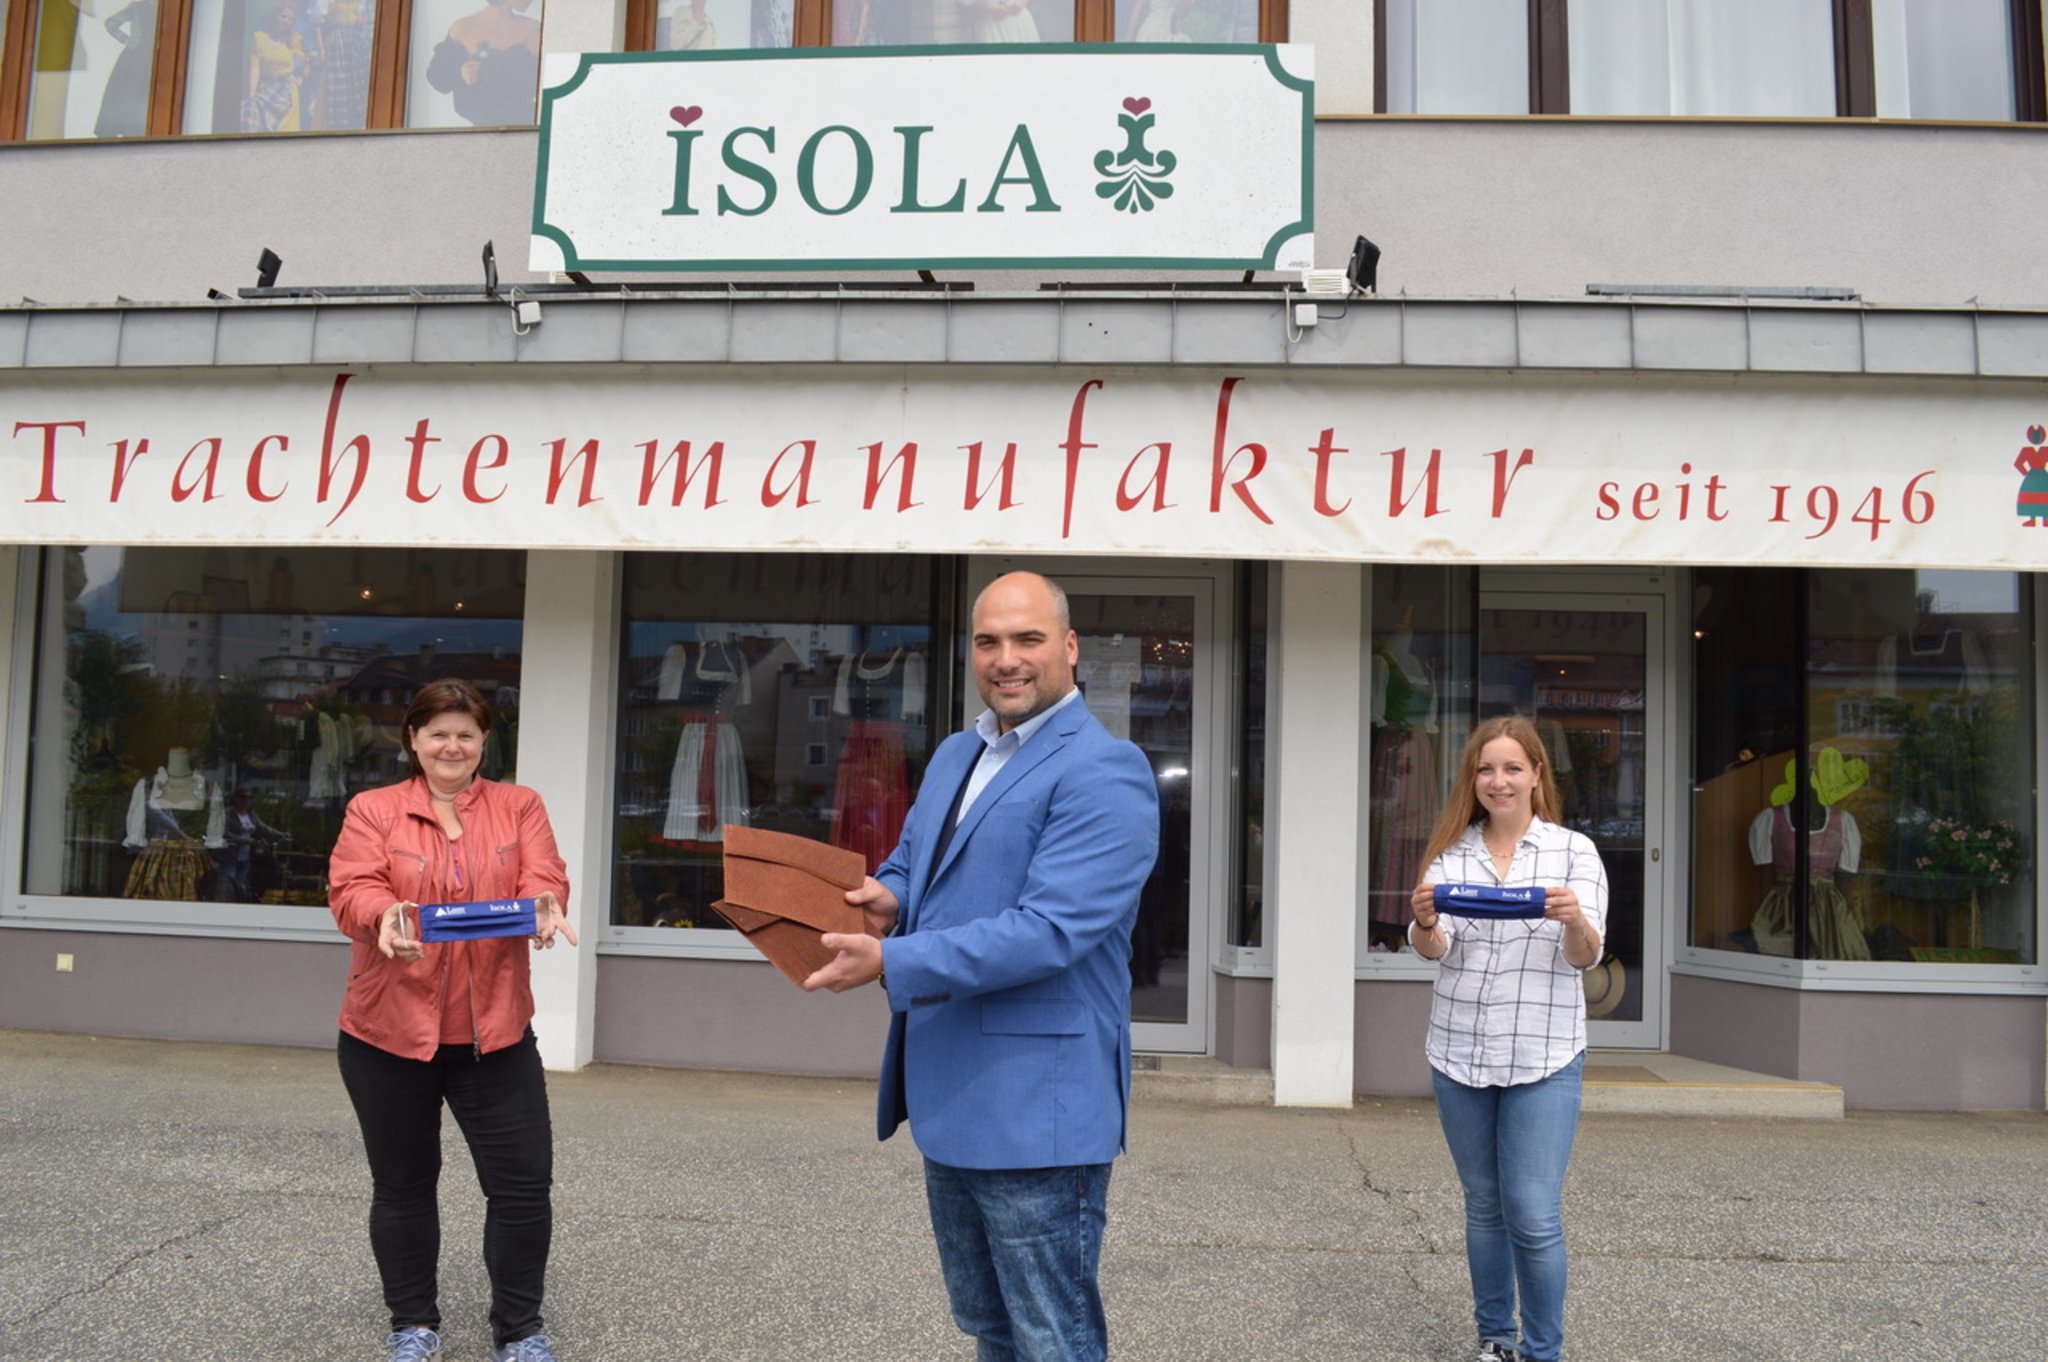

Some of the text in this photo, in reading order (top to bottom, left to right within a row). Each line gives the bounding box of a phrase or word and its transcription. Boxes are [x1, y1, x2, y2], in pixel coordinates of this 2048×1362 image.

[13, 373, 1937, 542] Trachtenmanufaktur seit 1946
